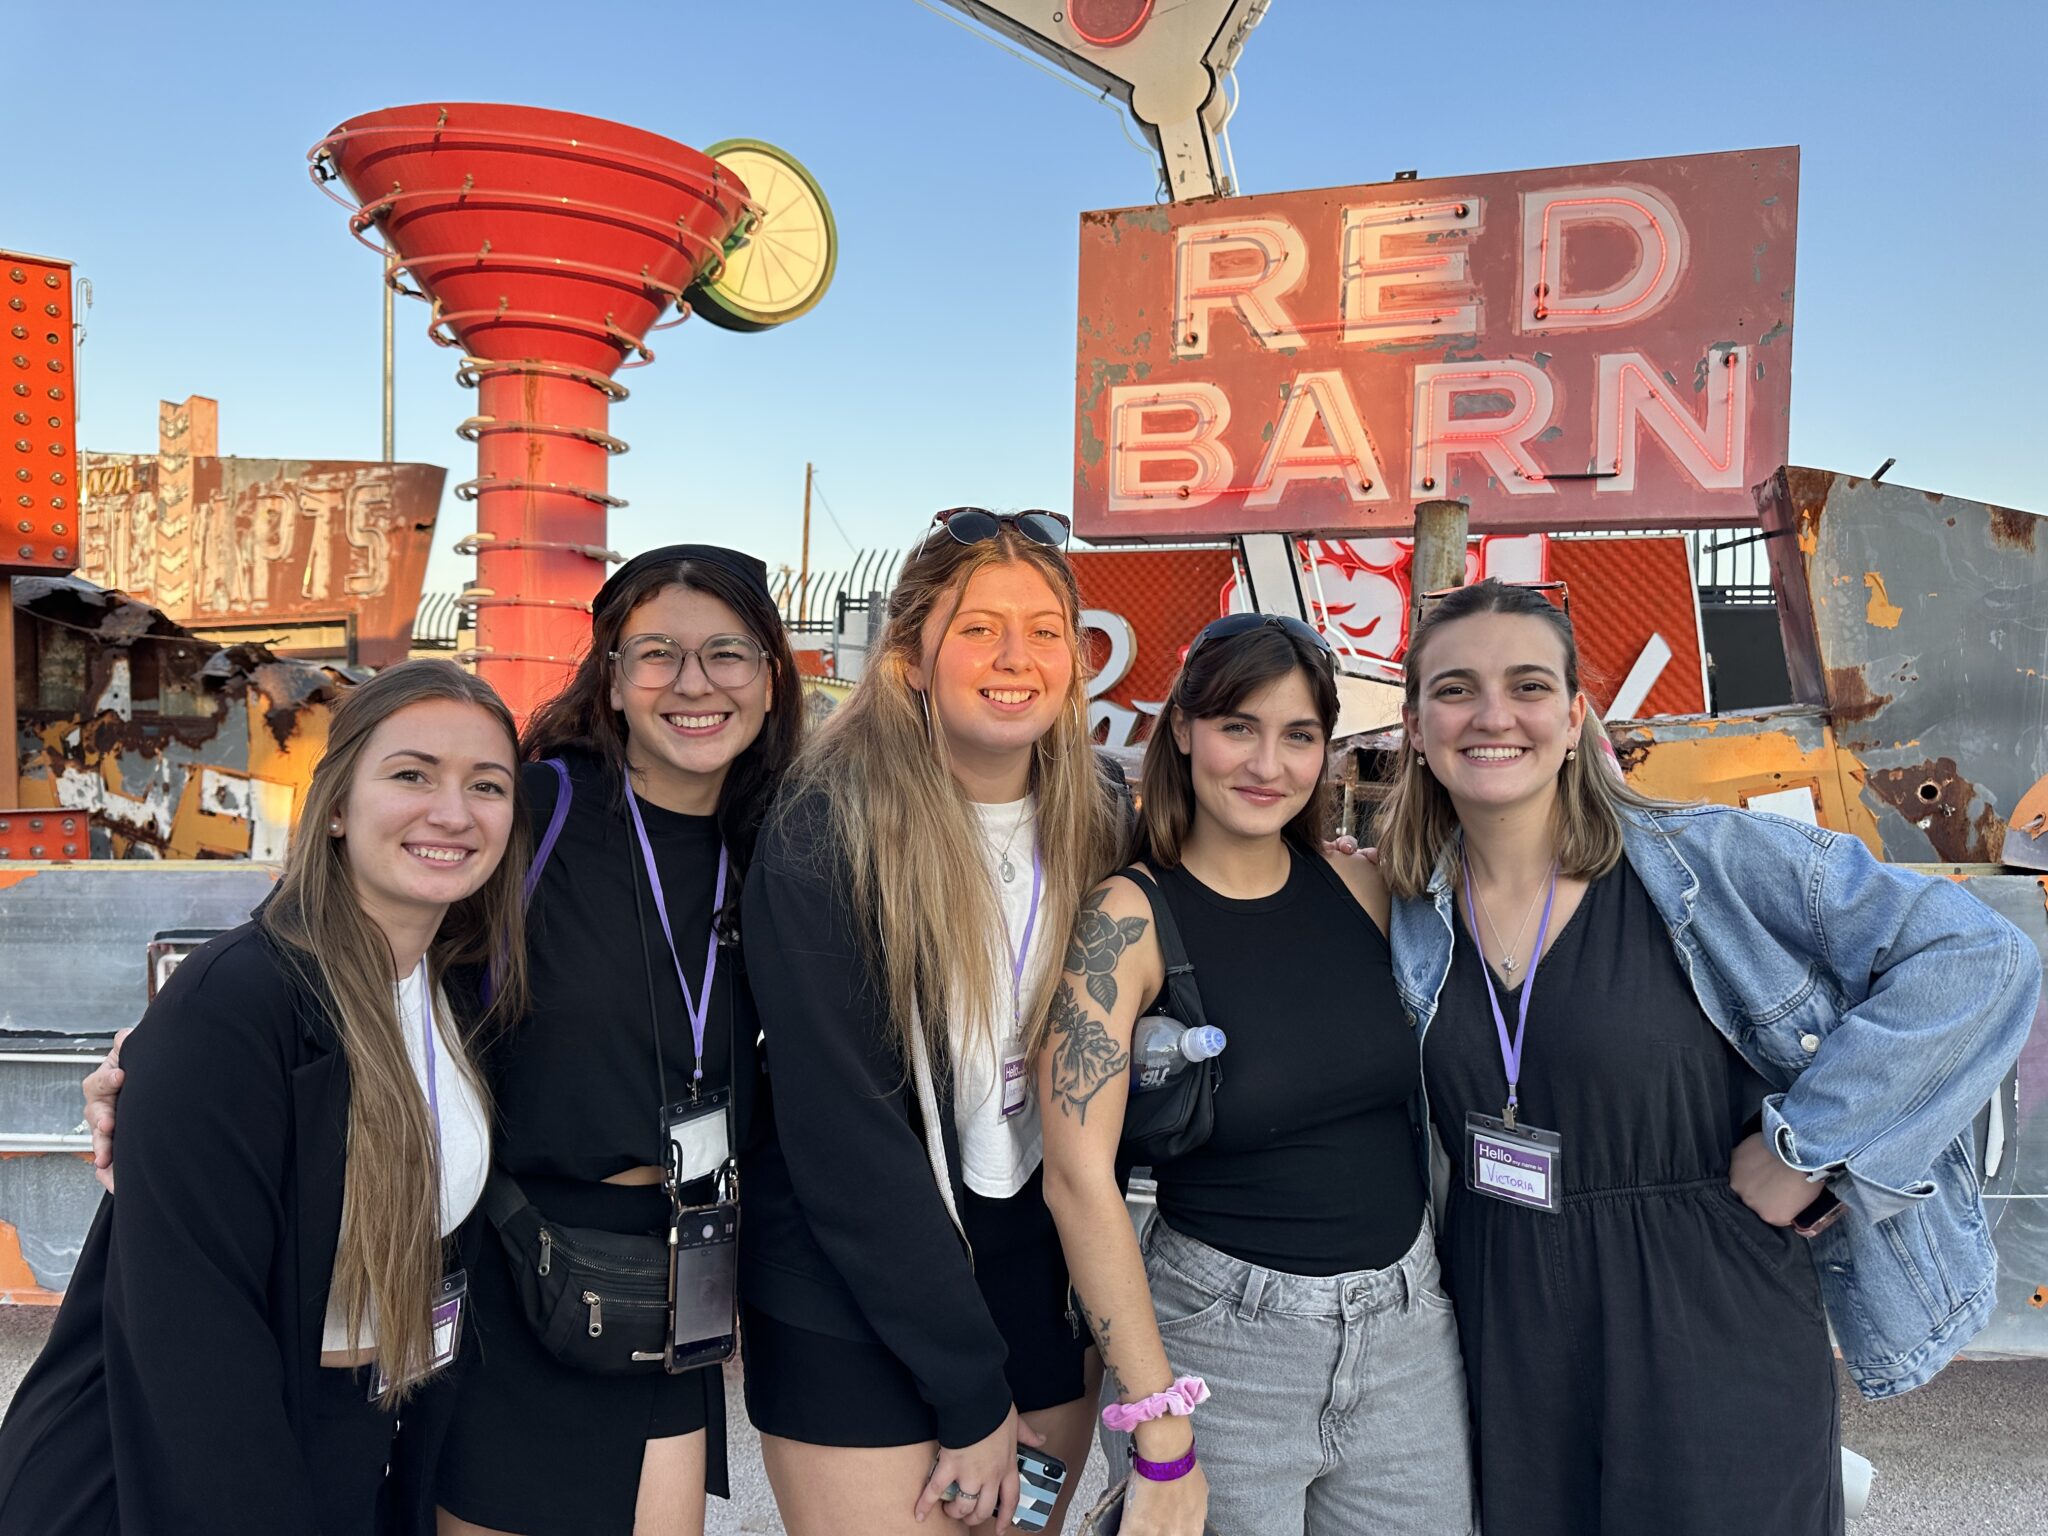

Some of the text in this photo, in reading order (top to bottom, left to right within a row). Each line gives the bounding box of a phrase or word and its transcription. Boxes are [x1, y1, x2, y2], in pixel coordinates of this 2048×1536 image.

[1175, 186, 1682, 355] RED
[1108, 346, 1747, 511] BARN
[1480, 1144, 1512, 1162] Hello
[1521, 1162, 1537, 1170] name
[1486, 1162, 1535, 1193] VICTORIA
